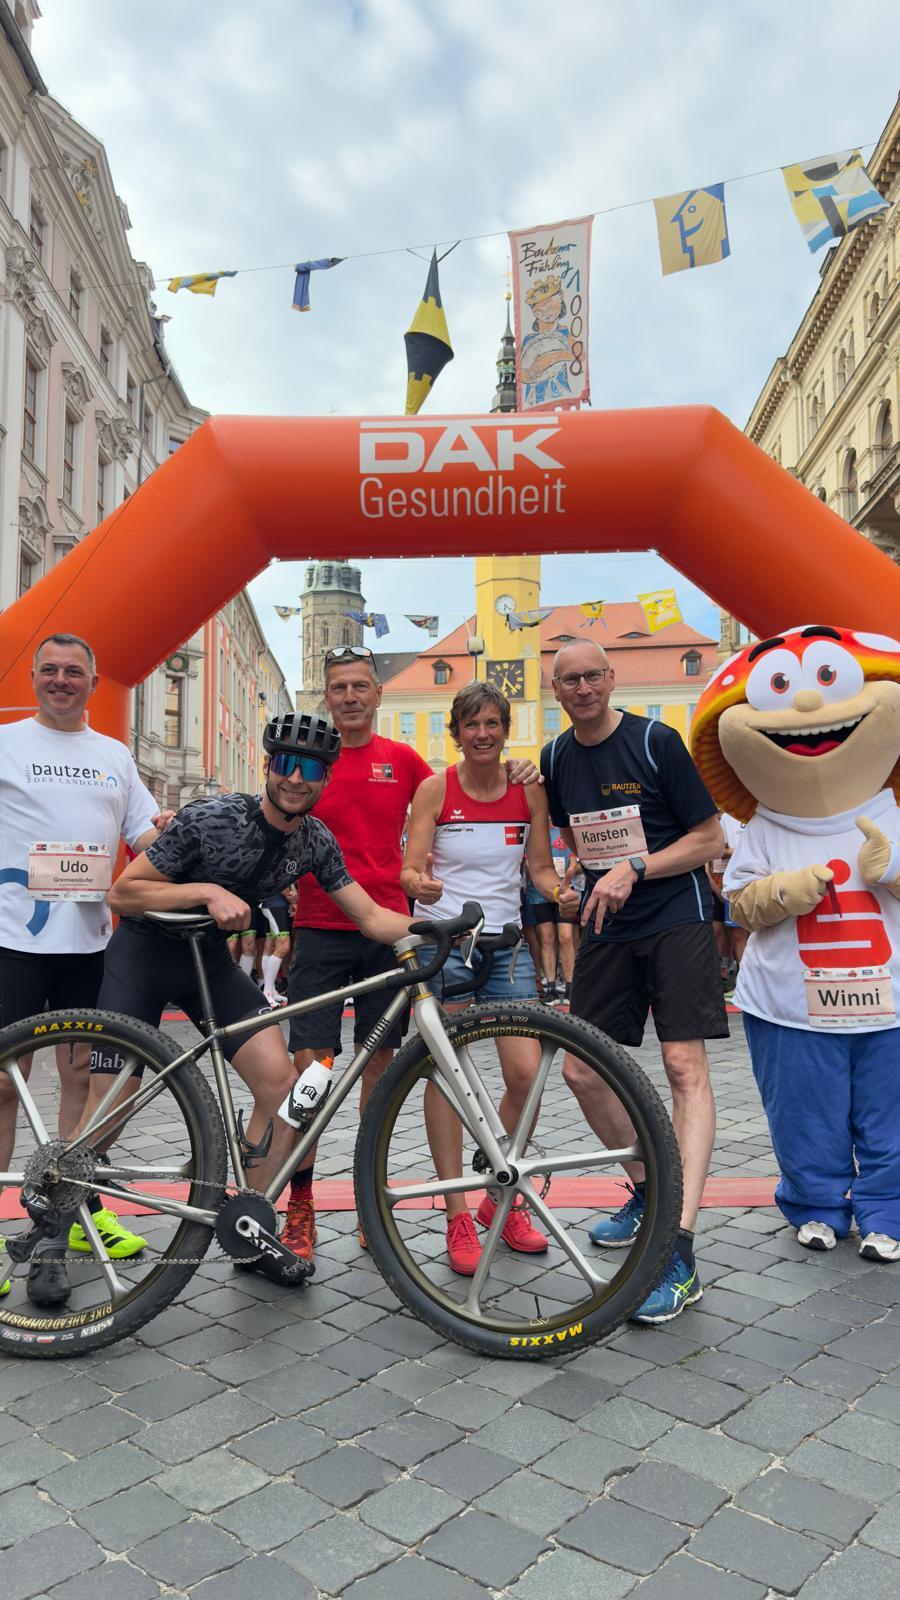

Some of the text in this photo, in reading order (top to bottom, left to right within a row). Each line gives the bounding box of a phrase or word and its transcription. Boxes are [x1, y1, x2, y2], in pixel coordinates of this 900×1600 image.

[359, 416, 566, 474] DAK
[360, 474, 566, 518] Gesundheit
[32, 763, 100, 779] bautzen
[581, 828, 629, 843] Karsten
[60, 860, 88, 873] Udo
[817, 987, 880, 1007] Winni
[33, 1021, 104, 1035] MAXXIS
[480, 1026, 540, 1038] COMPOSITES
[509, 1322, 583, 1346] MAXXIS
